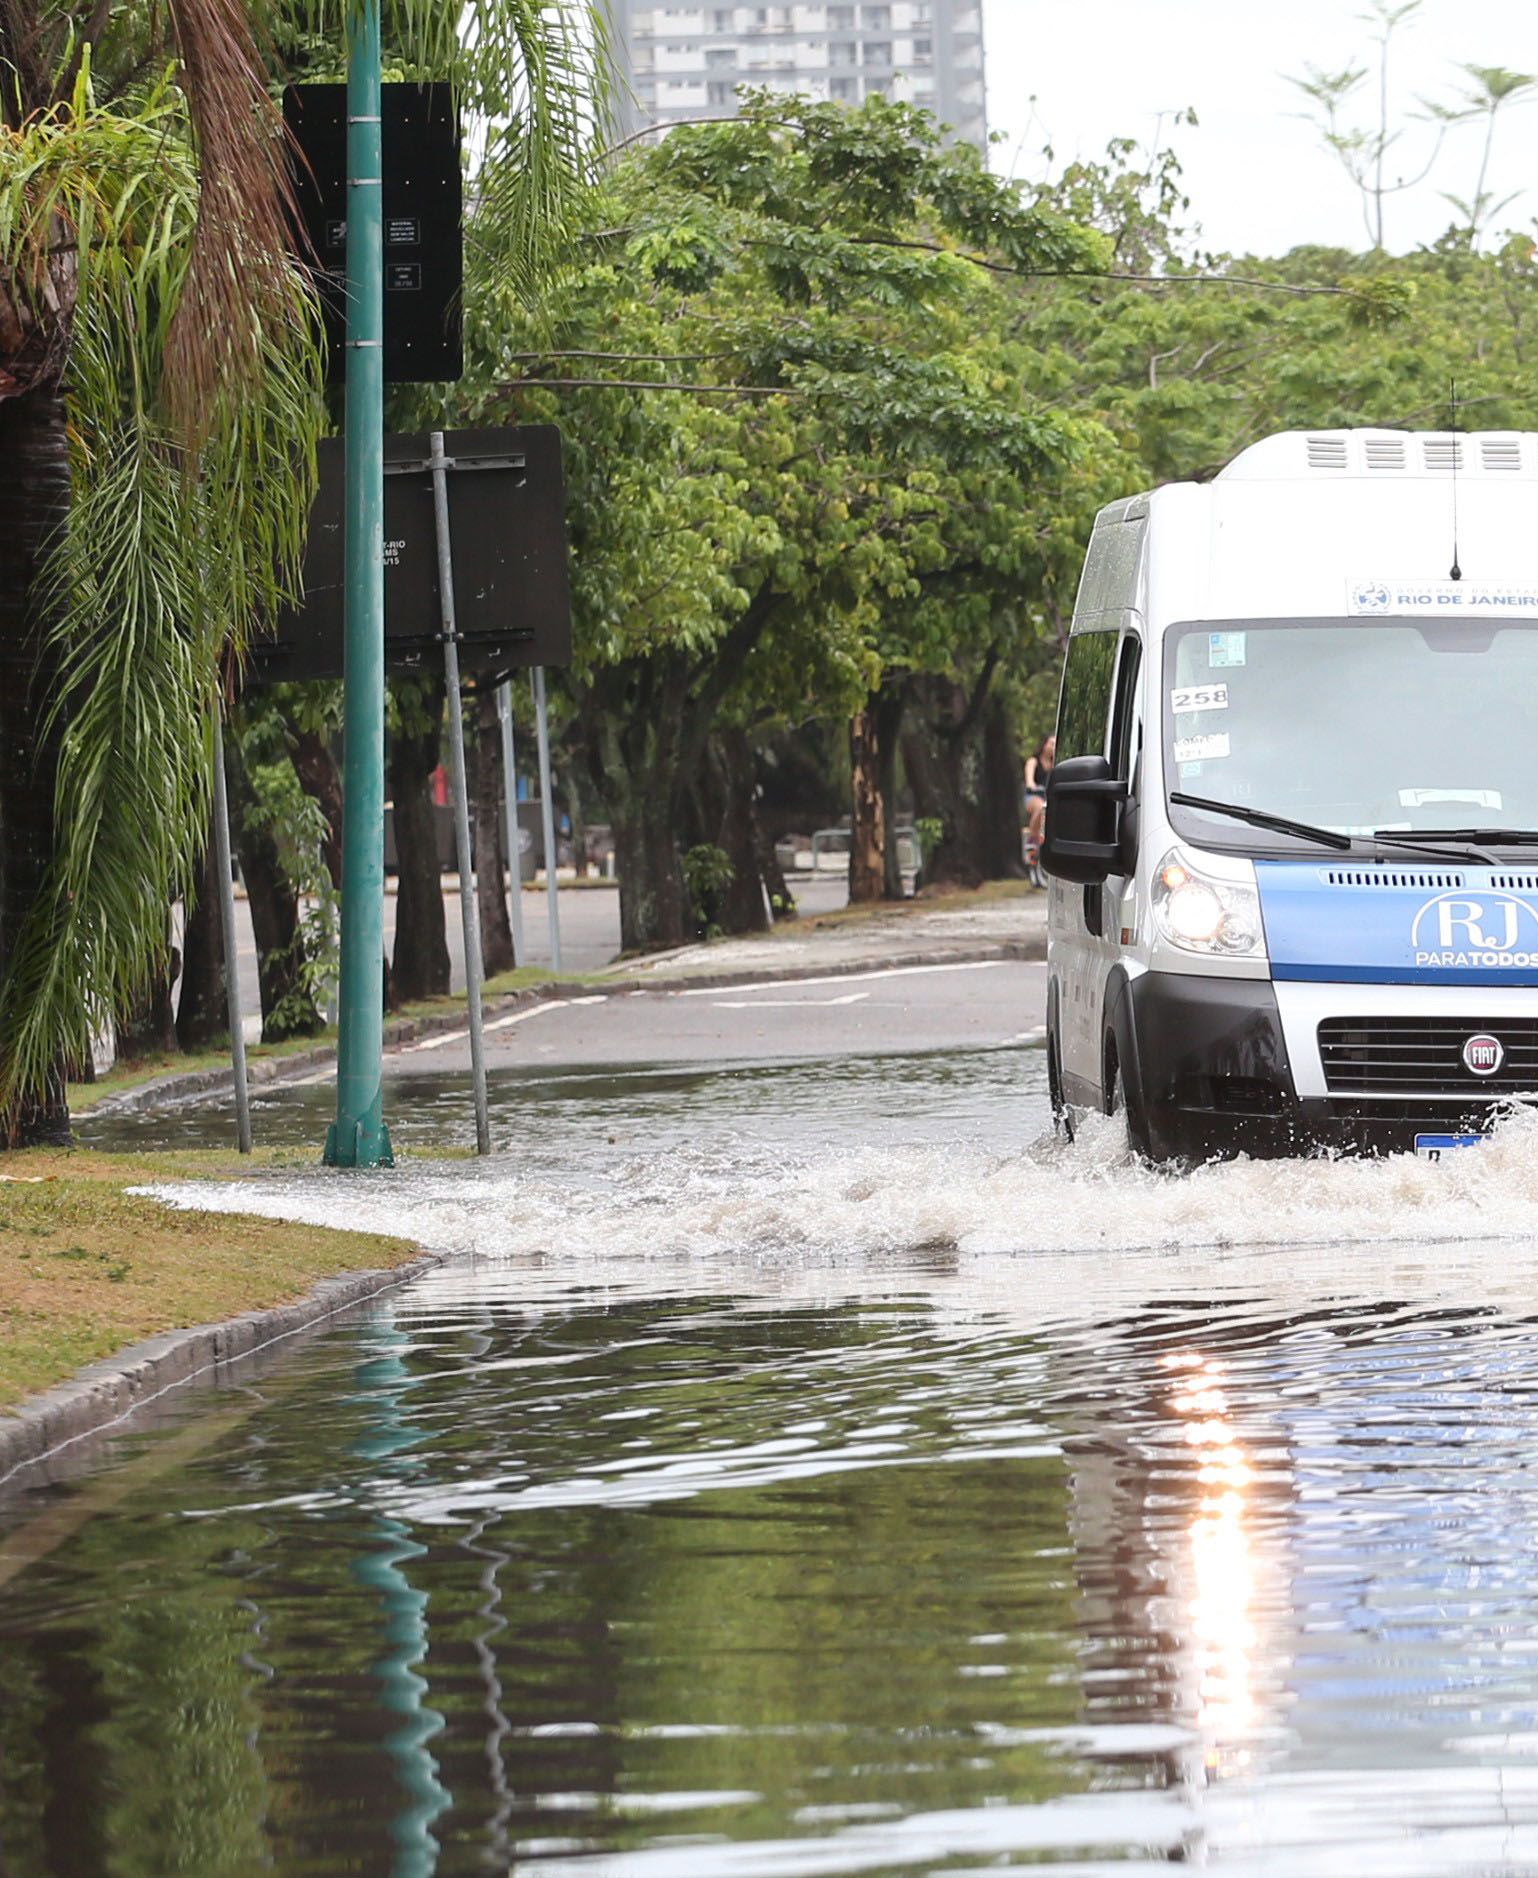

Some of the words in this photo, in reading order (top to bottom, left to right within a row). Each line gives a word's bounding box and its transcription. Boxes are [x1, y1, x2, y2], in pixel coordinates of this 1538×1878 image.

[1398, 595, 1432, 605] RIO
[1437, 595, 1462, 605] DE
[1175, 690, 1227, 707] 258
[1438, 901, 1518, 951] RJ
[1471, 1046, 1496, 1065] FIAT
